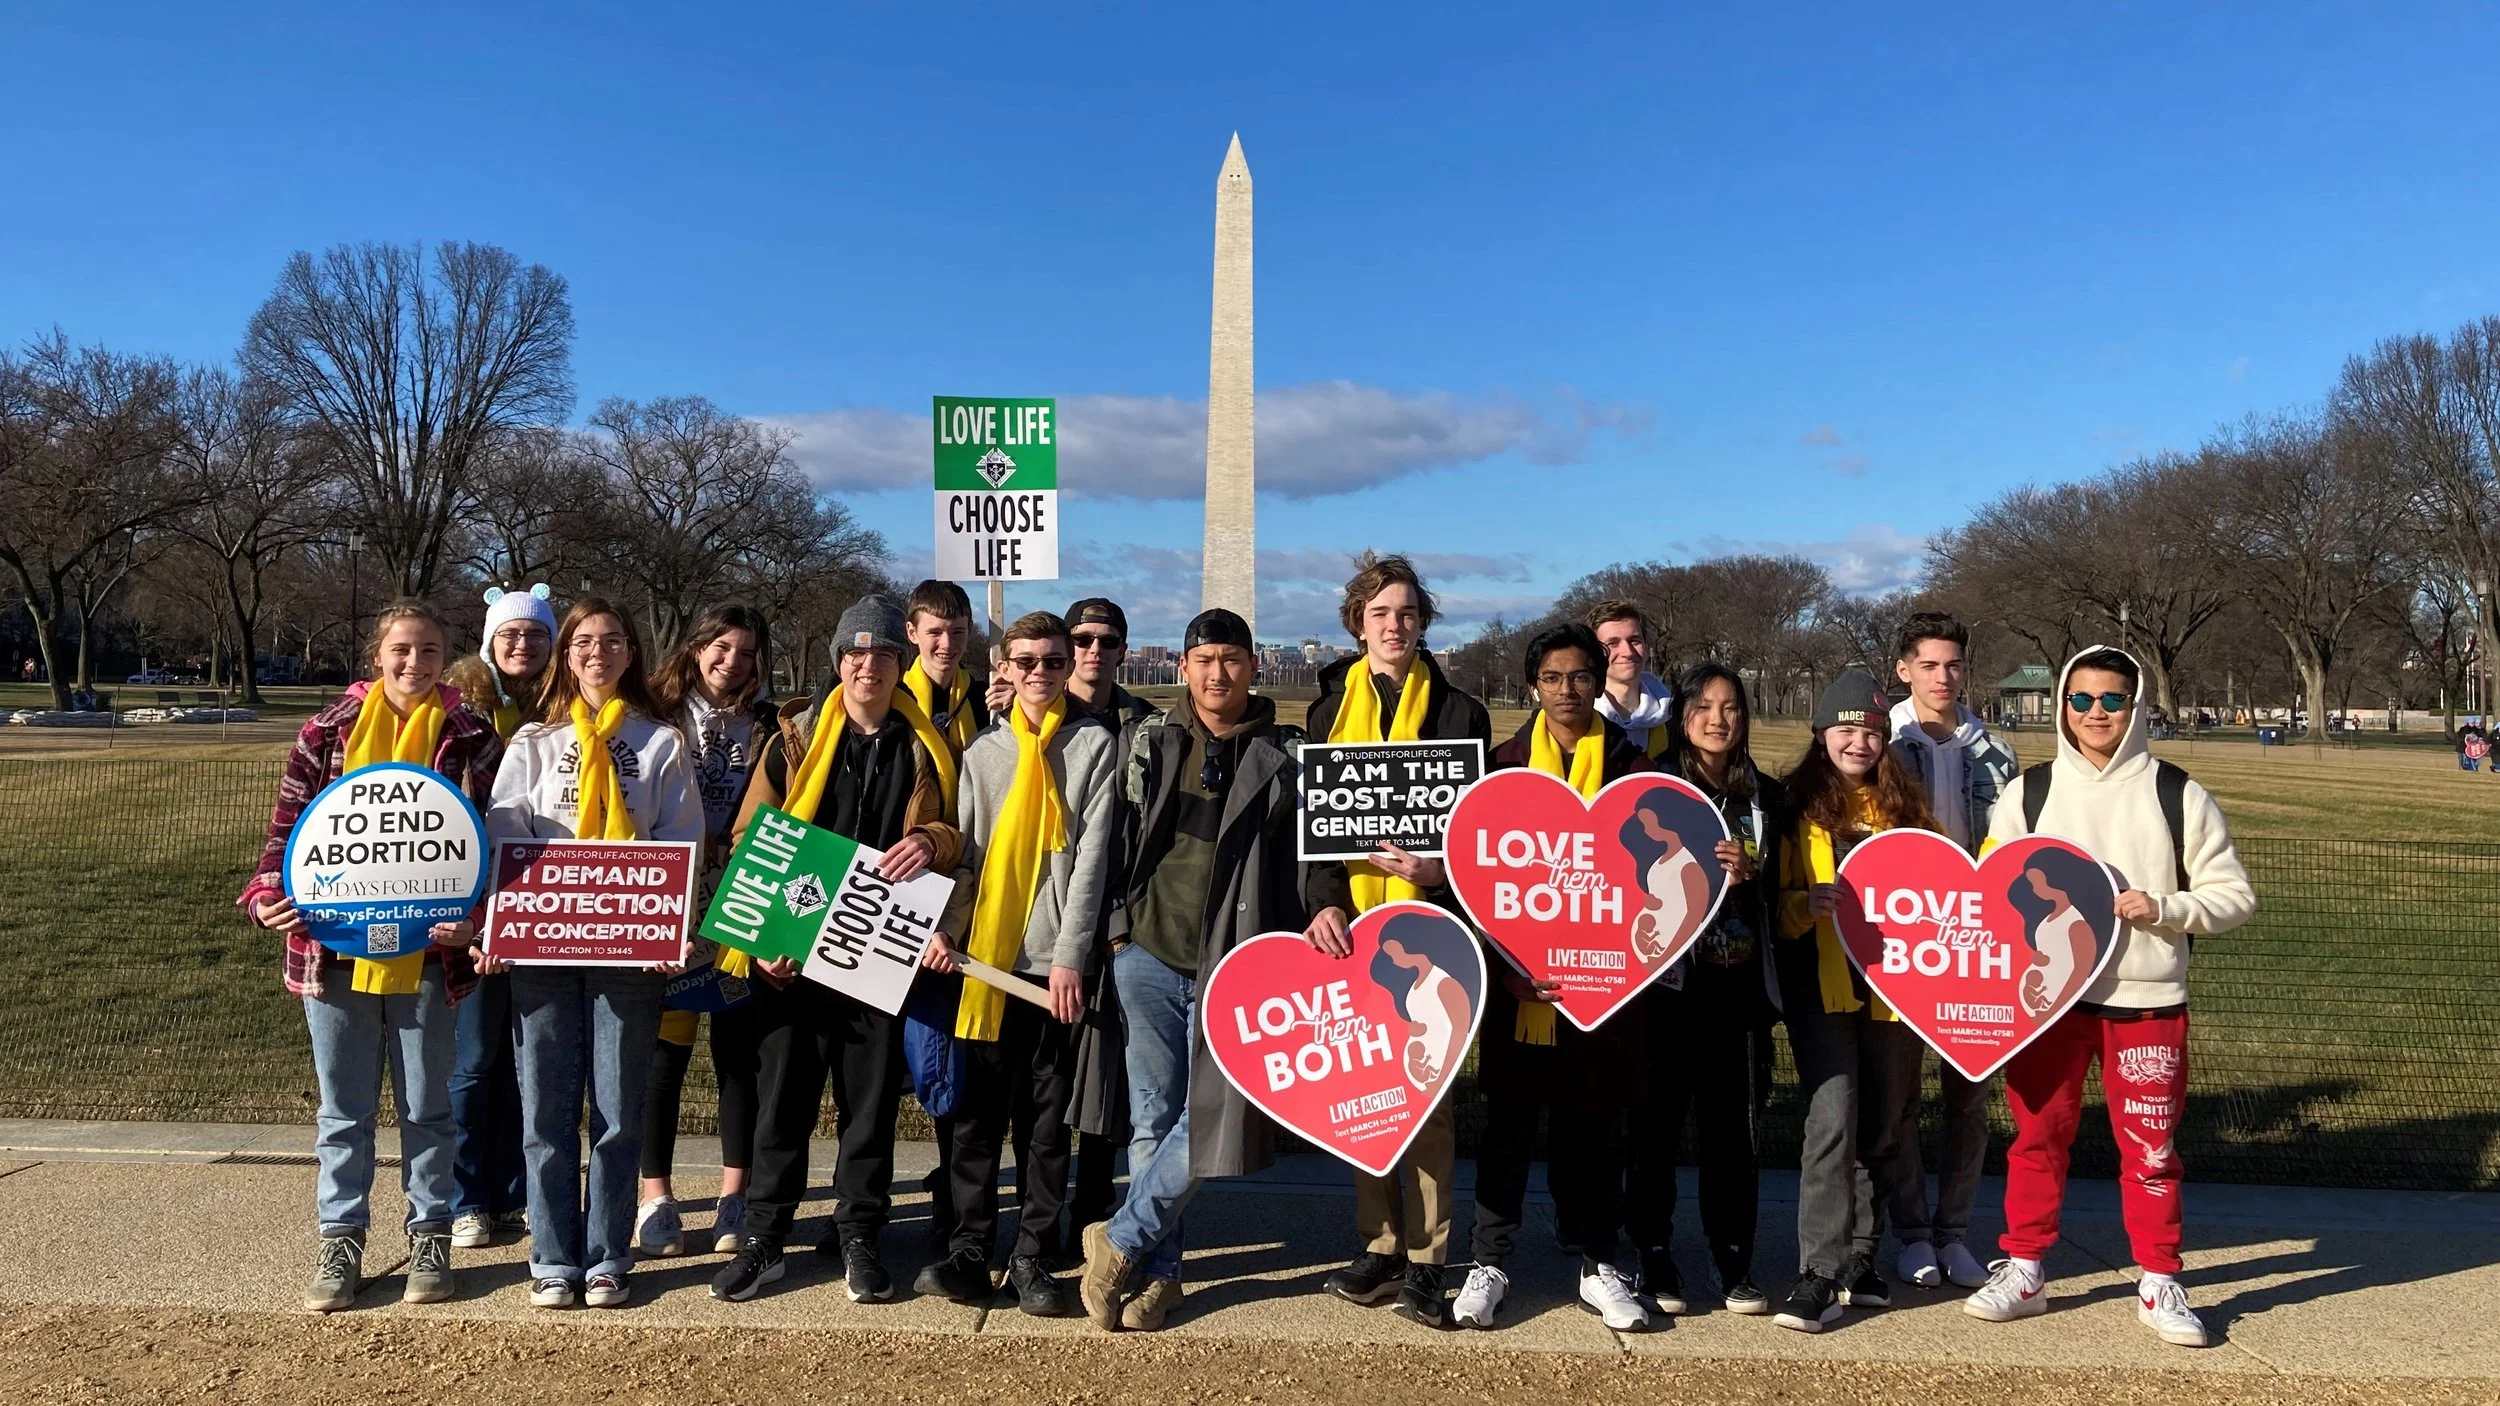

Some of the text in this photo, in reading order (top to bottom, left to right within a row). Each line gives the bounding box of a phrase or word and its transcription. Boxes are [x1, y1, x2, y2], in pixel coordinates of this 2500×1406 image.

[940, 406, 1050, 444] LOVE LIFE
[950, 494, 1044, 533] CHOOSE
[974, 538, 1022, 576] LIFE
[1838, 711, 1865, 721] HADES
[1316, 761, 1465, 783] I AM THE
[350, 781, 425, 805] PRAY
[328, 810, 444, 835] TO END
[303, 839, 466, 866] ABORTION
[745, 812, 808, 874] LIFE
[1476, 829, 1594, 870] LOVE
[522, 865, 667, 886] I DEMAND
[1528, 857, 1609, 890] them
[304, 905, 463, 925] 40DaysForLife.com
[496, 891, 684, 916] PROTECTION
[714, 868, 780, 943] LOVE
[816, 860, 894, 971] CHOOSE
[1494, 881, 1623, 924] BOTH
[1864, 886, 1983, 928] LOVE
[499, 922, 676, 941] AT CONCEPTION
[872, 903, 934, 969] LIFE
[1916, 916, 1997, 947] them
[537, 946, 557, 954] TEXT
[558, 946, 591, 954] ACTION
[1547, 948, 1624, 968] LIVE ACTION
[1882, 937, 2011, 980] BOTH
[1564, 974, 1594, 982] MARCH
[1234, 979, 1354, 1045] LOVE
[1936, 1002, 2012, 1021] LIVE ACTION
[1290, 1011, 1372, 1045] them
[1952, 1028, 1982, 1036] MARCH
[1264, 1023, 1394, 1092] BOTH
[1329, 1088, 1405, 1124] LIVE ACTION
[1349, 1120, 1379, 1134] MARCH
